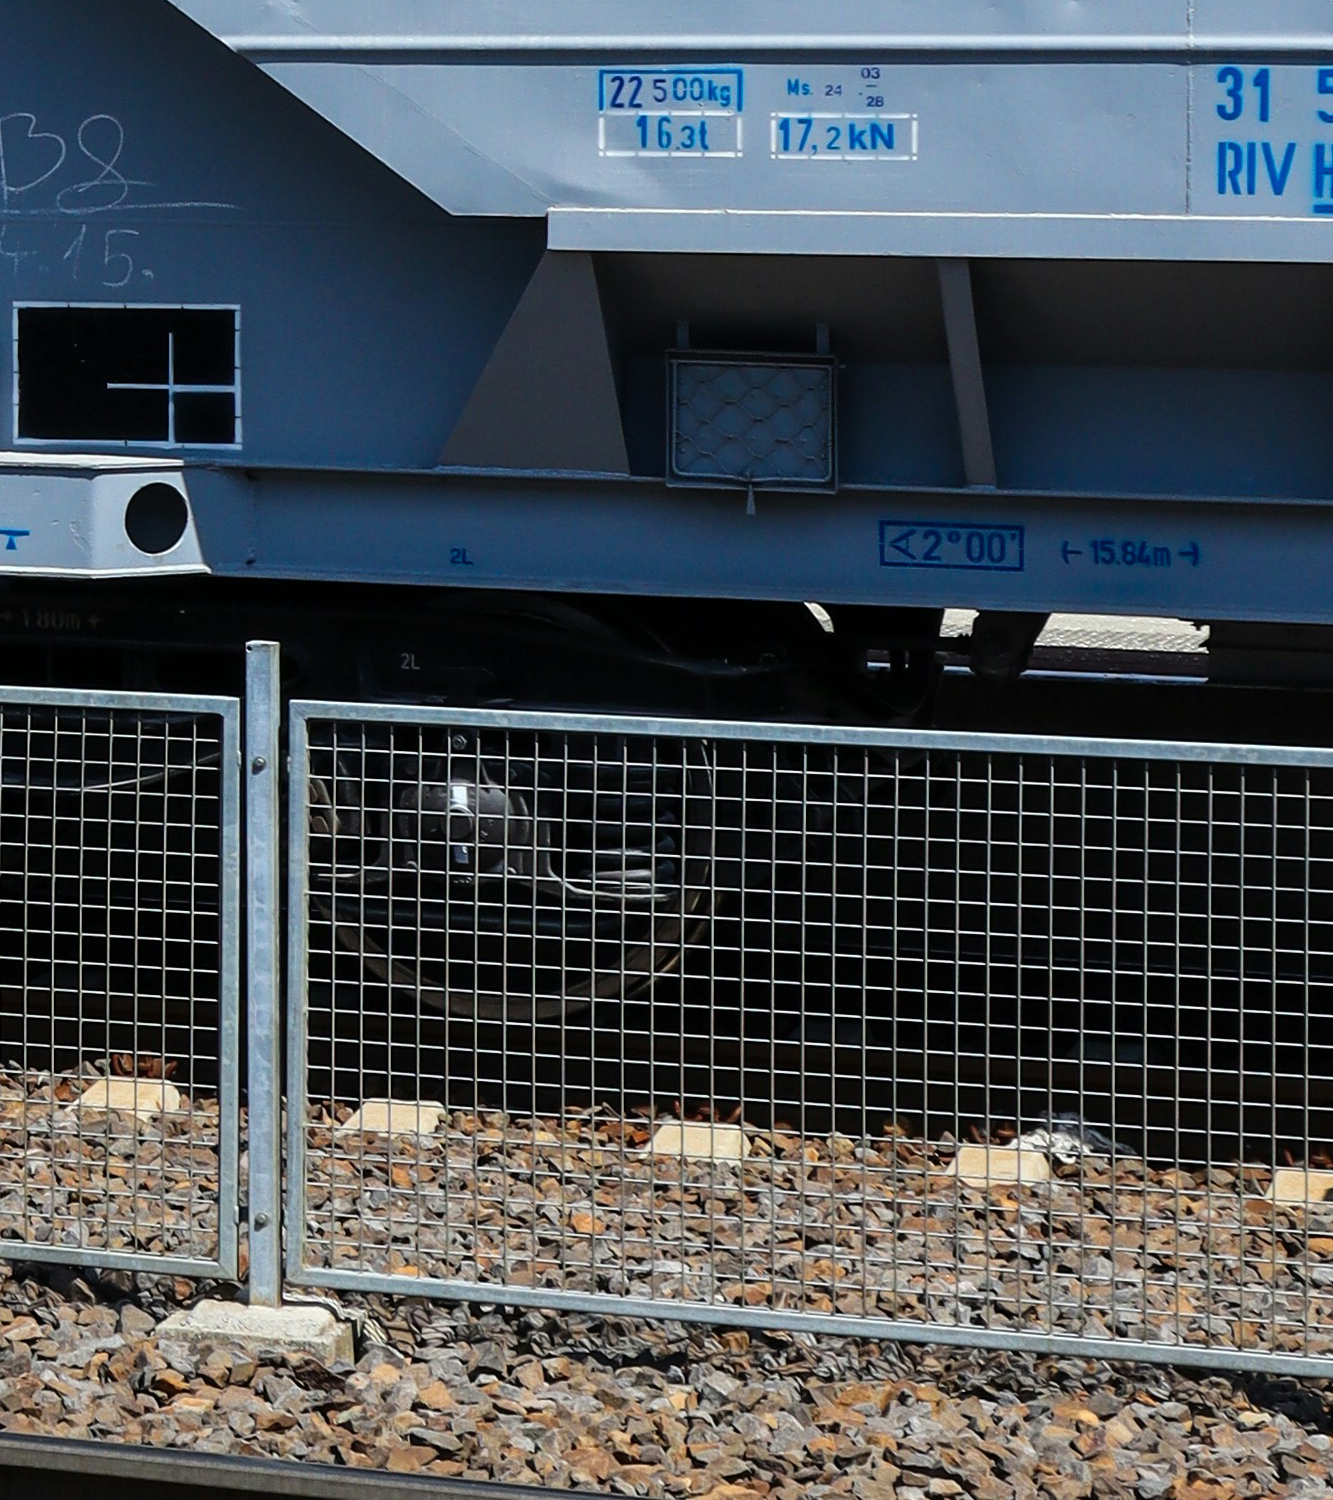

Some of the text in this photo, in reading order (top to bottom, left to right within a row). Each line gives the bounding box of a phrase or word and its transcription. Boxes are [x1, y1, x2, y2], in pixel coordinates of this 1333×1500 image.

[824, 84, 842, 96] 24
[1216, 66, 1270, 123] 31
[1217, 141, 1297, 196] RIV
[449, 547, 474, 566] 2L
[400, 652, 421, 670] 2L
